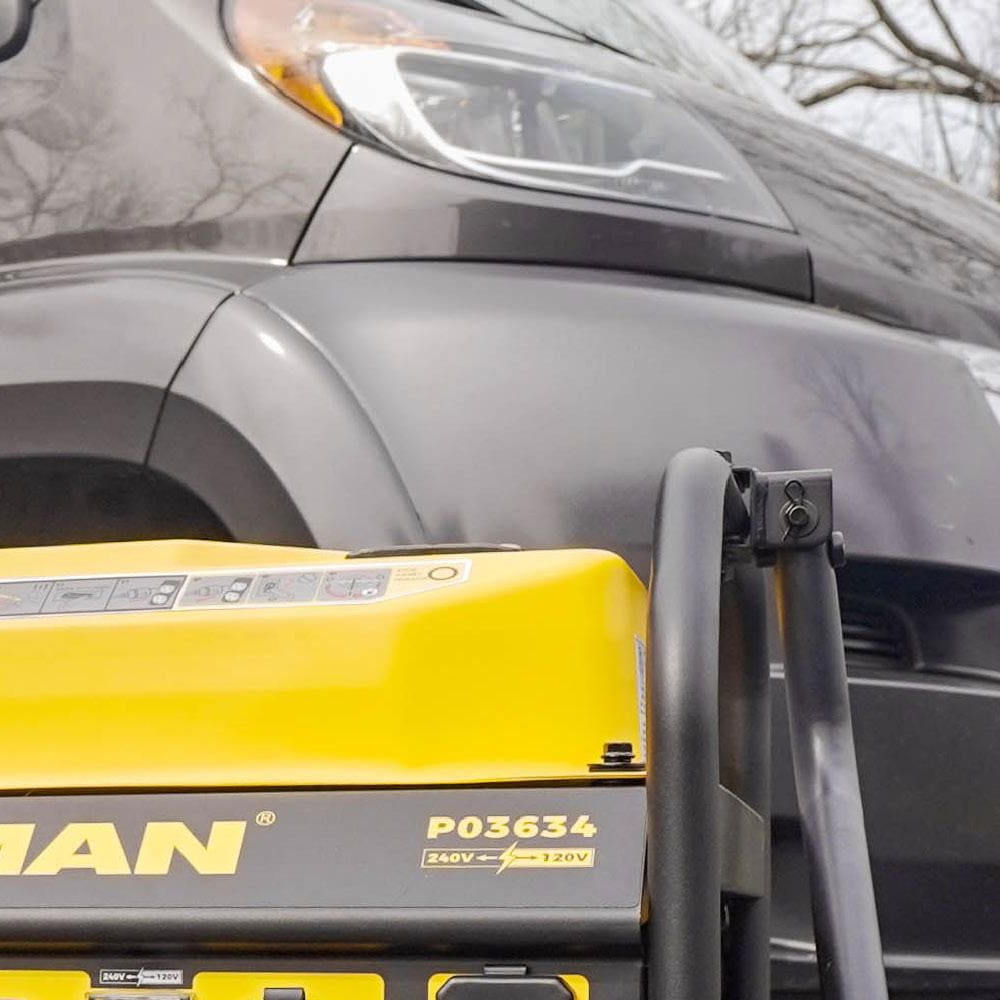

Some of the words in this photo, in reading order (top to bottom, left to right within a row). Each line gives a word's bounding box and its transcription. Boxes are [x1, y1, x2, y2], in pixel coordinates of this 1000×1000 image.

[427, 815, 598, 839] P03634
[427, 852, 475, 864] 240V
[543, 853, 589, 863] 120V
[102, 972, 126, 981] 240V
[157, 973, 179, 981] 120V
